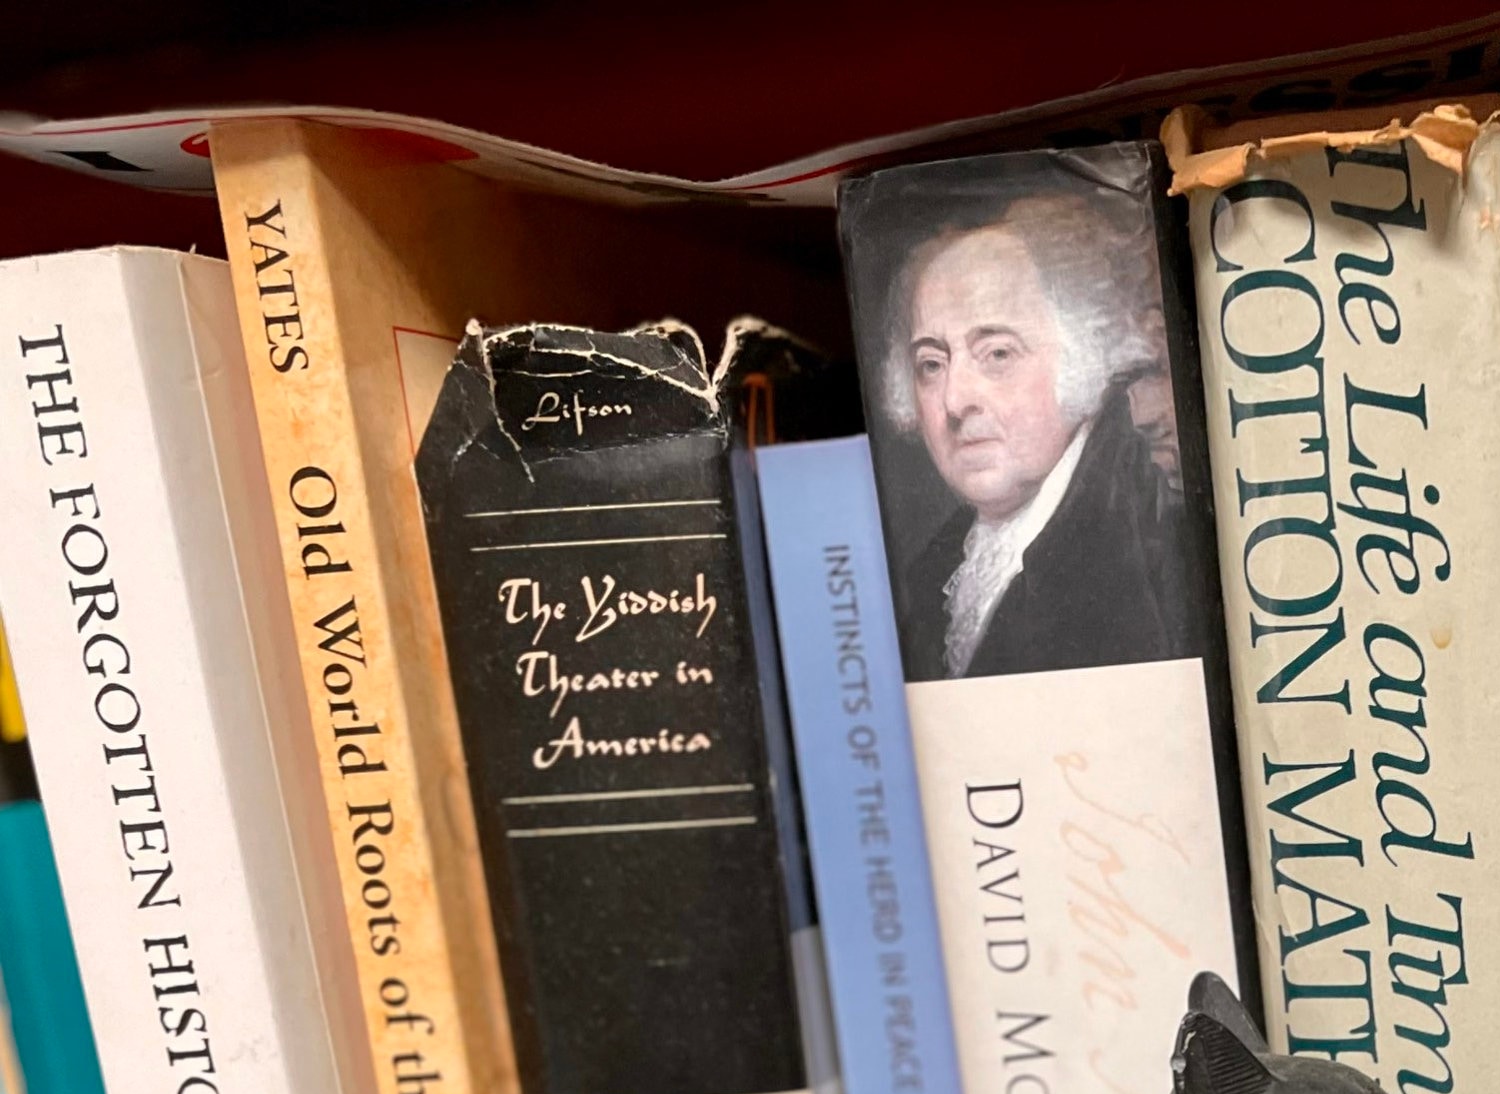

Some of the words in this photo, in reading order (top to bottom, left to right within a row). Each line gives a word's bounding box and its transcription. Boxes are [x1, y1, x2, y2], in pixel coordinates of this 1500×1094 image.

[244, 199, 310, 374] YATES
[18, 324, 88, 466] THE
[522, 391, 633, 435] Lifson
[1210, 179, 1353, 715] COTTON
[288, 465, 353, 580] Old
[1338, 373, 1452, 595] Life
[498, 577, 567, 646] The
[575, 573, 717, 643] Yiddish
[823, 543, 873, 716] INSTINCTS
[49, 483, 182, 909] FORGOTTEN
[313, 595, 388, 778] World
[516, 650, 660, 718] Theater
[676, 660, 713, 686] in
[533, 716, 712, 769] America
[847, 725, 880, 770] OF
[1362, 622, 1475, 867] and
[852, 775, 889, 848] THE
[964, 777, 1032, 974] DAVID
[347, 799, 402, 957] Roots
[866, 855, 904, 946] HERD
[379, 977, 434, 1035] of
[878, 950, 906, 992] IN
